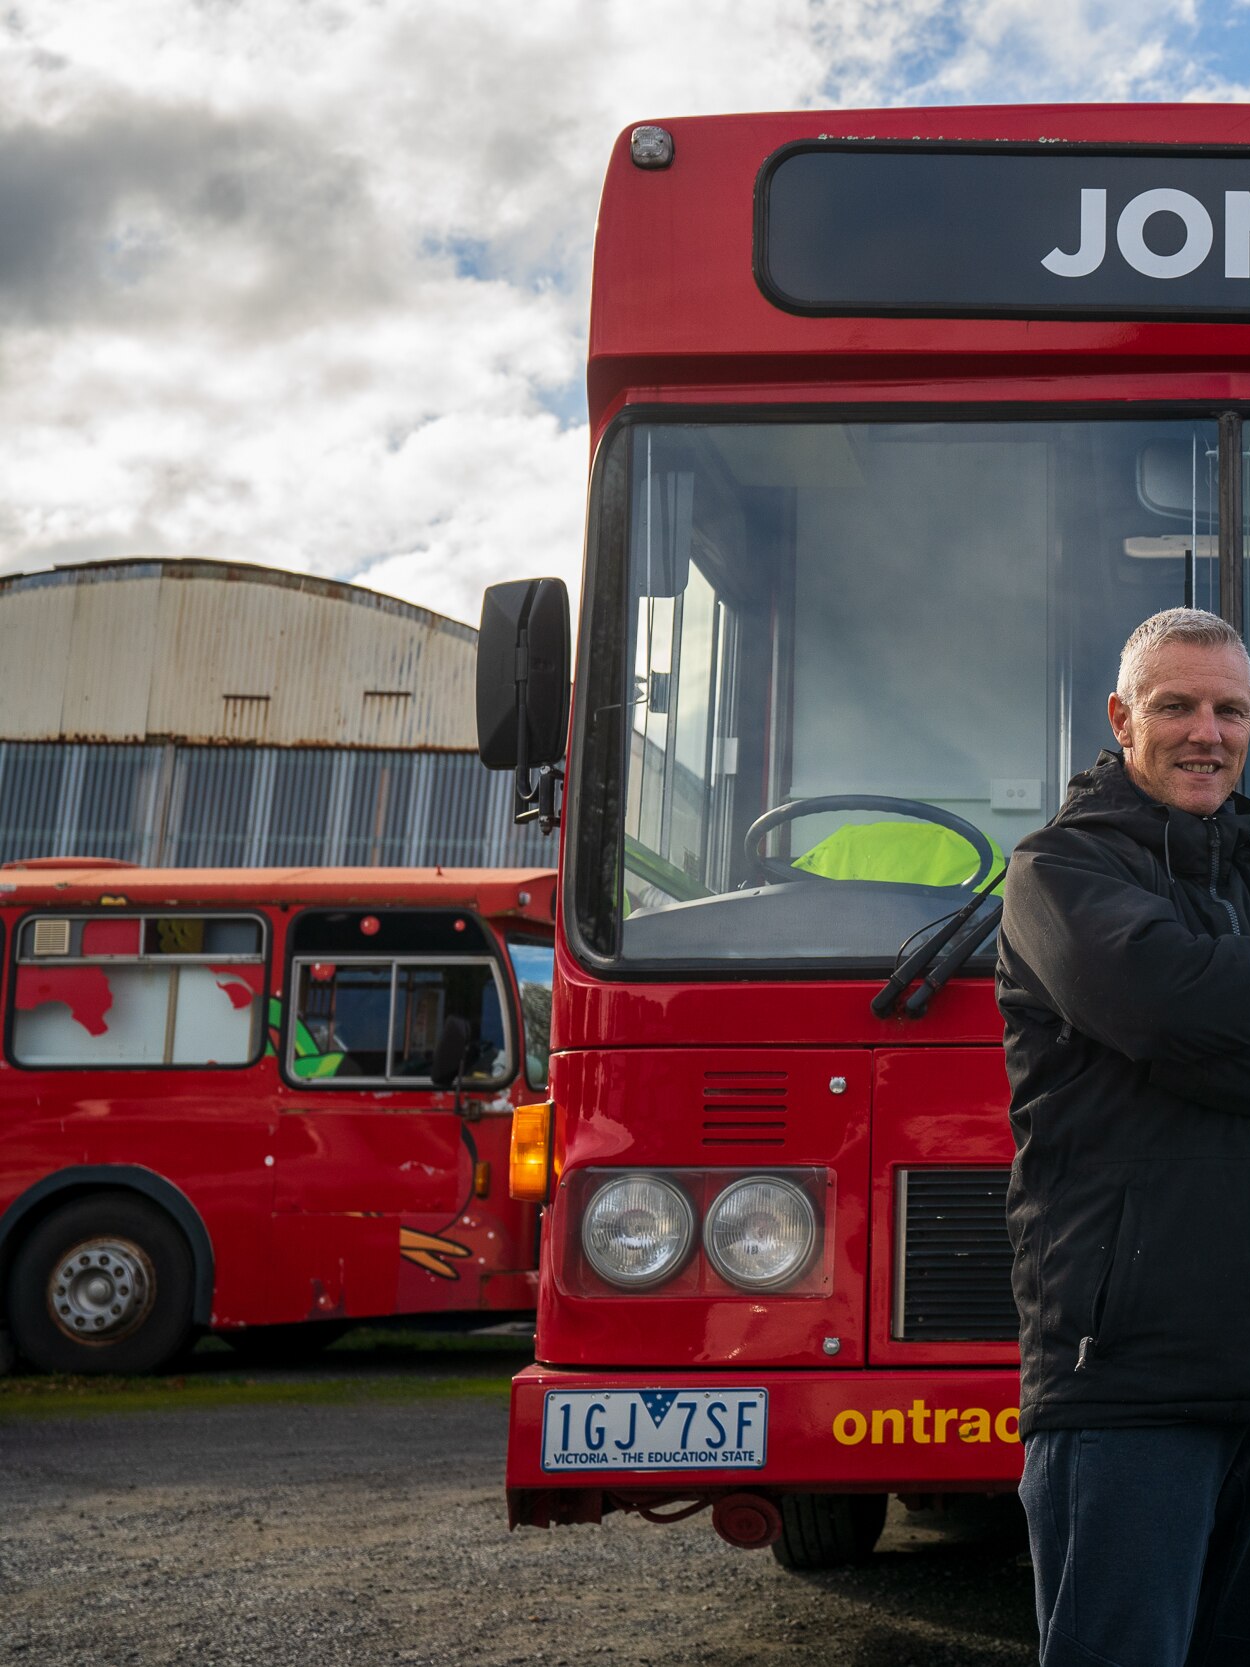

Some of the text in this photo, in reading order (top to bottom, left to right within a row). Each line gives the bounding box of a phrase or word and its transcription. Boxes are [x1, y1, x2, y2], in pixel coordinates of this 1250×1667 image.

[560, 1401, 757, 1451] 1GJ 7SF
[553, 1452, 608, 1464] VICTORIA
[621, 1452, 644, 1463] THE
[648, 1450, 718, 1463] EDUCATION
[721, 1450, 755, 1462] STATE
